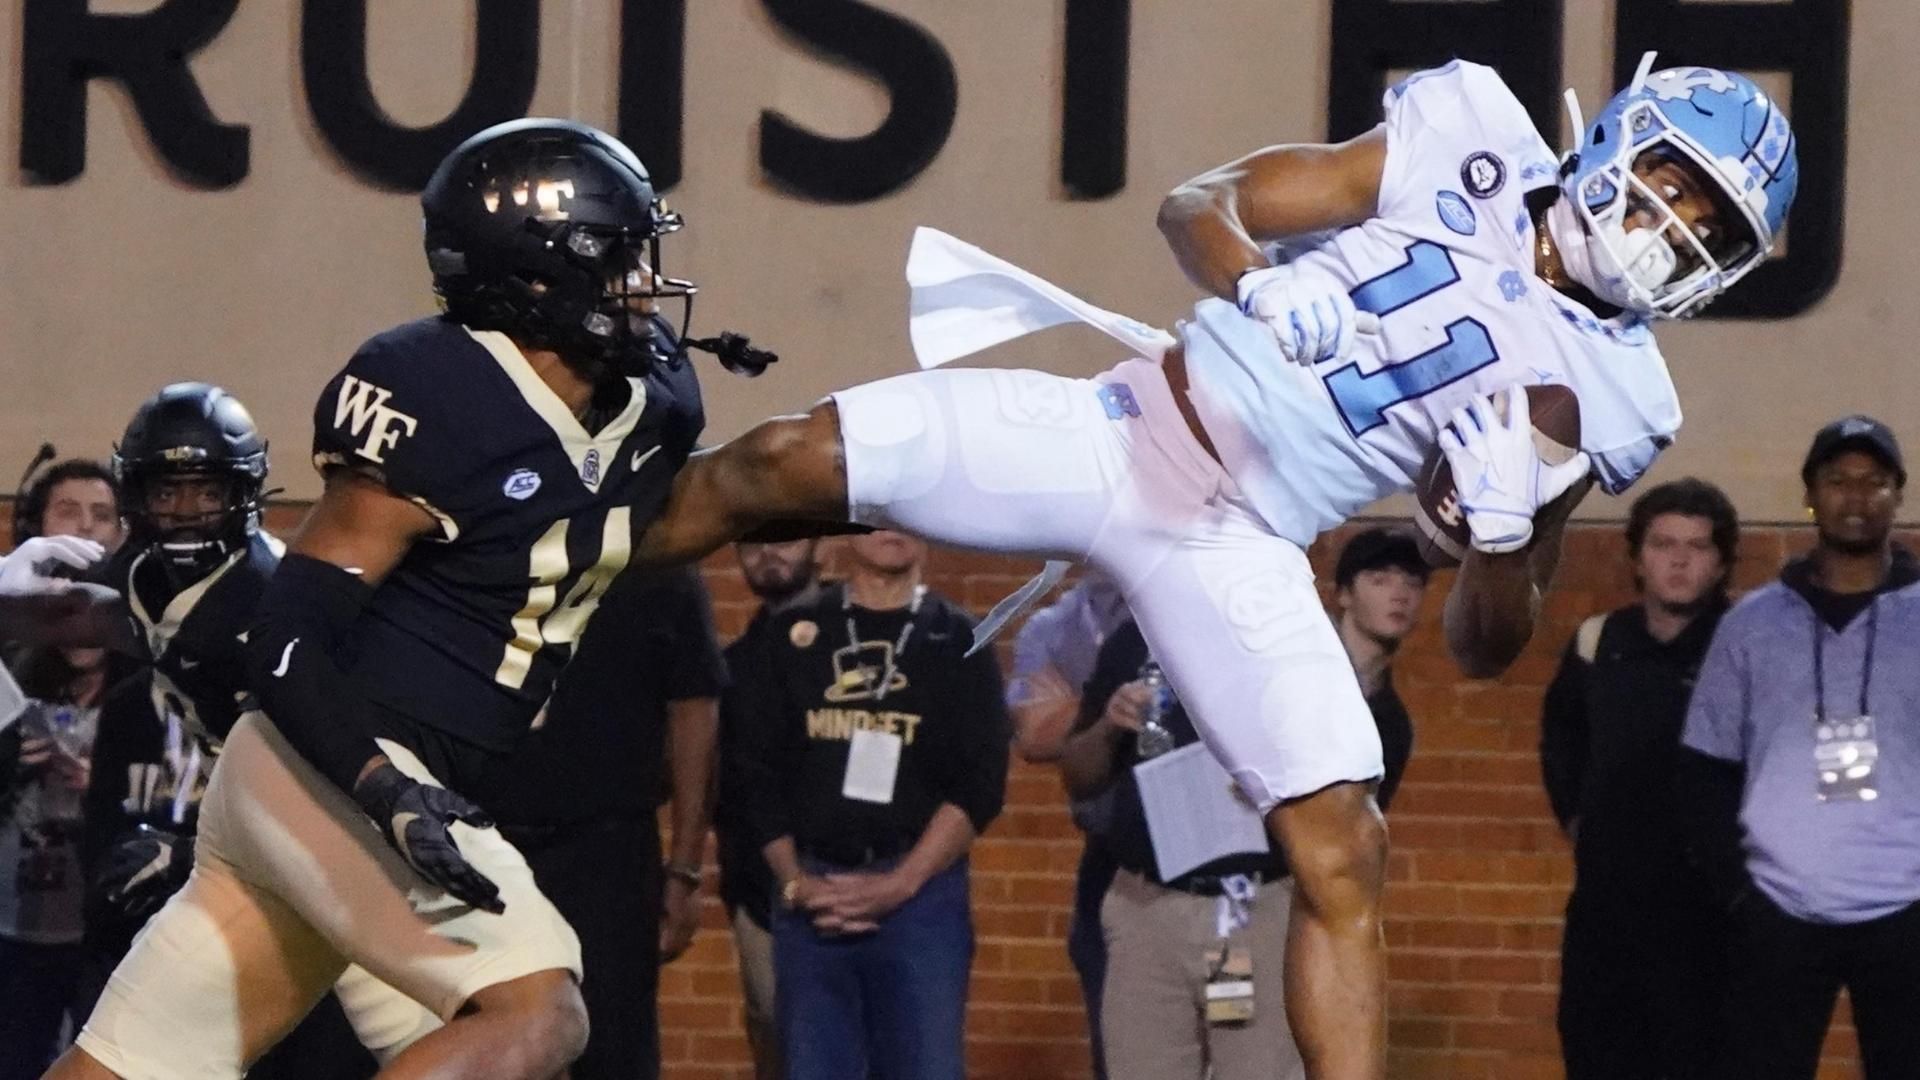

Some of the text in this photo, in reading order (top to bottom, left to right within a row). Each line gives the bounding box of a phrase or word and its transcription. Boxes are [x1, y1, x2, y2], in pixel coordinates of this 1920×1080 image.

[333, 374, 417, 464] WF
[1314, 239, 1499, 438] 11
[495, 506, 631, 689] 14
